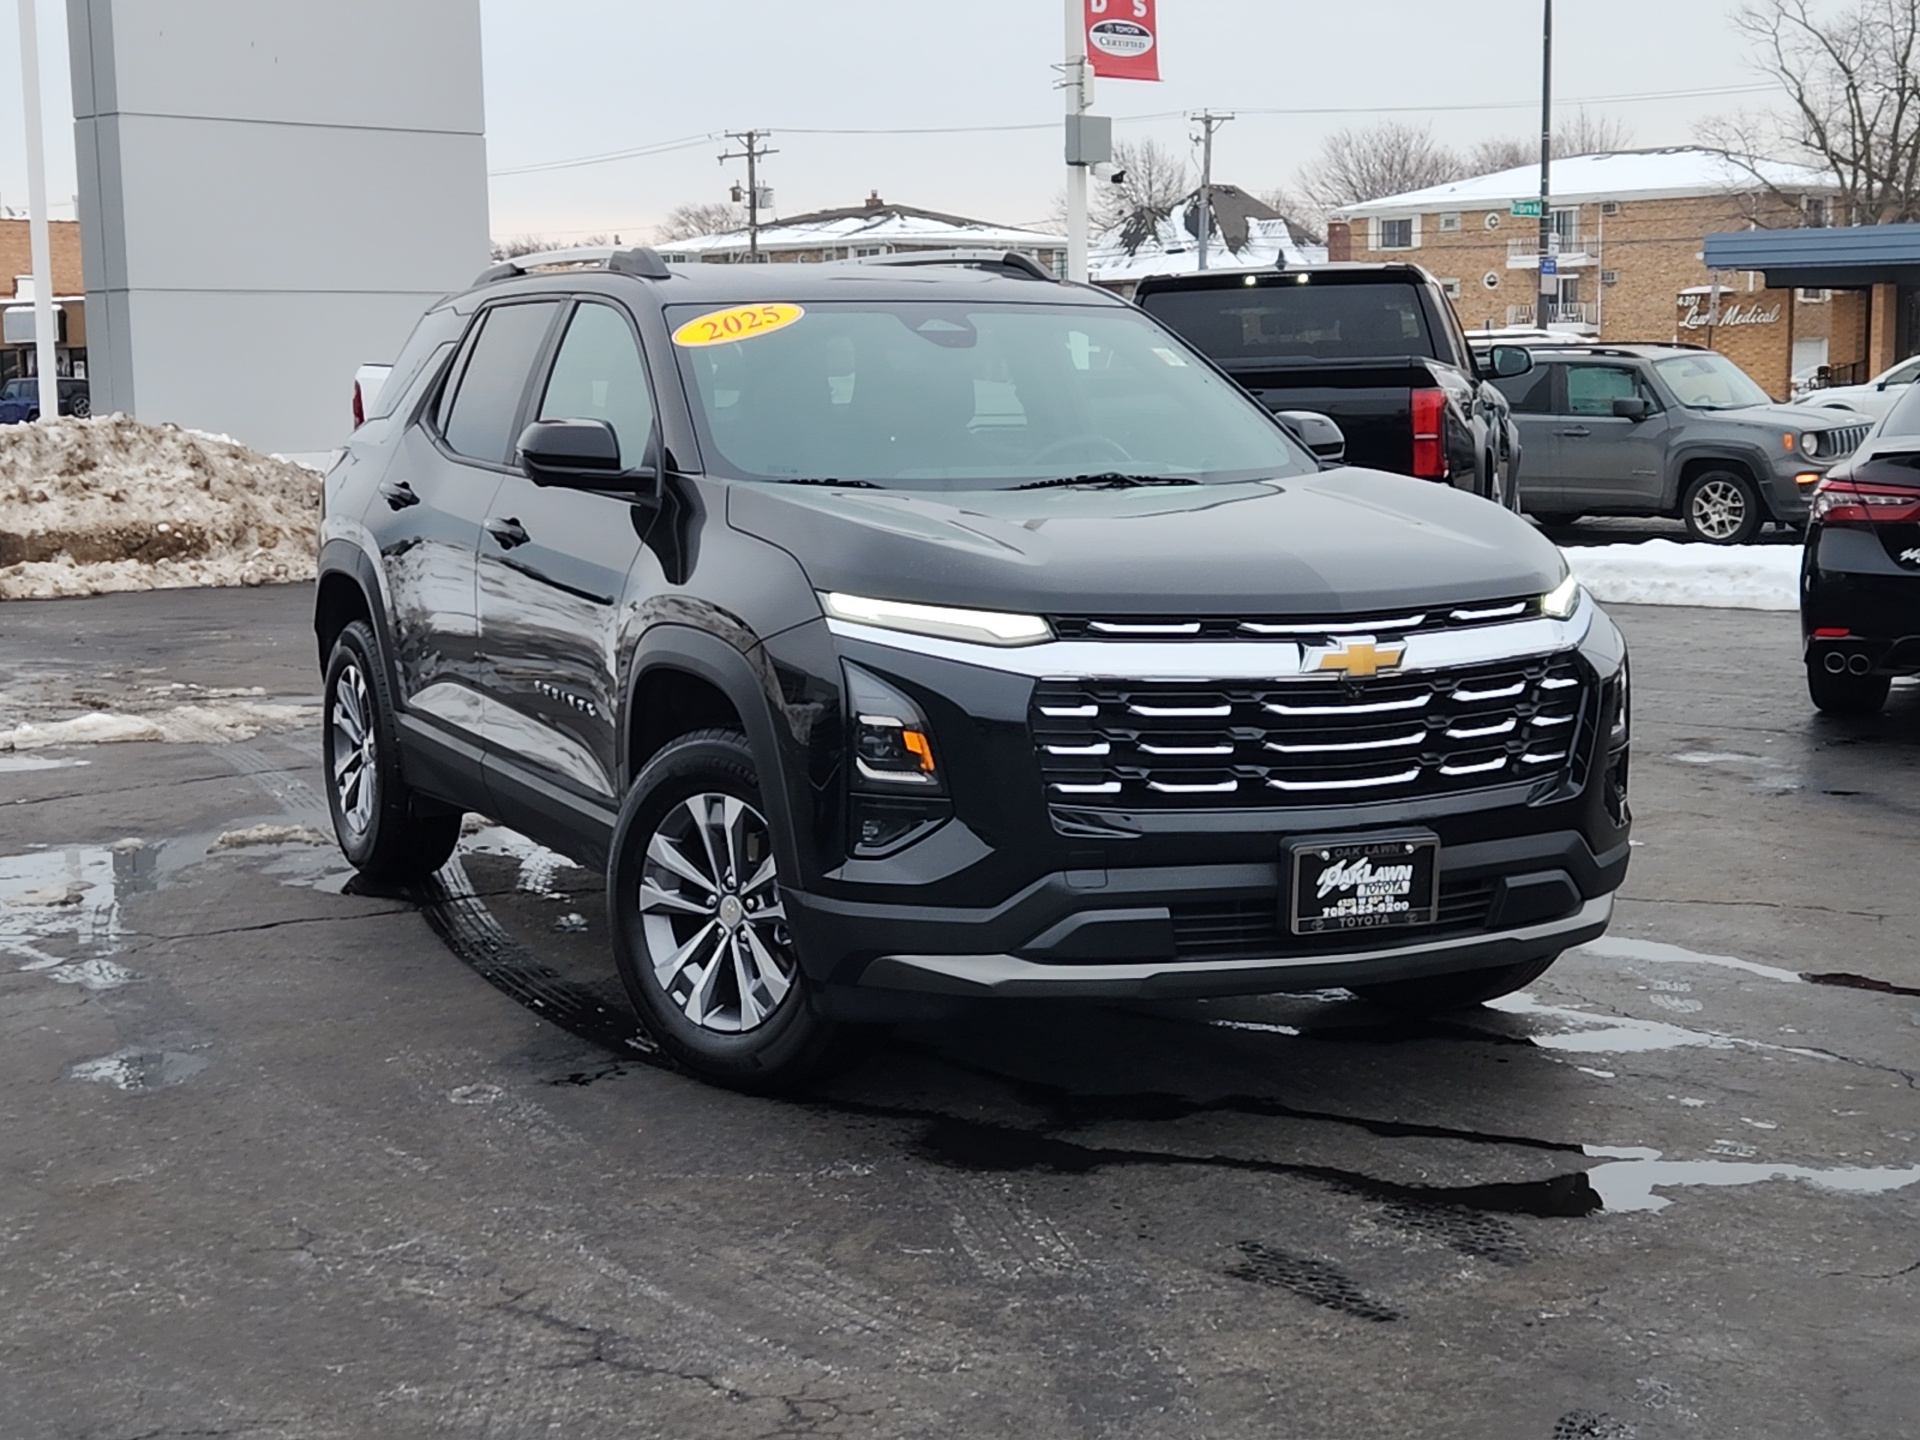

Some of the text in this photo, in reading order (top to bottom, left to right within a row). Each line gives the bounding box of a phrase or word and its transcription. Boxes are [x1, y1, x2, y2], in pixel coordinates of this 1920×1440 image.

[1677, 295, 1701, 307] 4301
[1719, 303, 1781, 327] Medical
[701, 306, 780, 341] 2025
[1335, 844, 1400, 857] OAK LAWN
[1364, 882, 1404, 895] TOYOTA
[1338, 914, 1390, 928] TOYOTA
